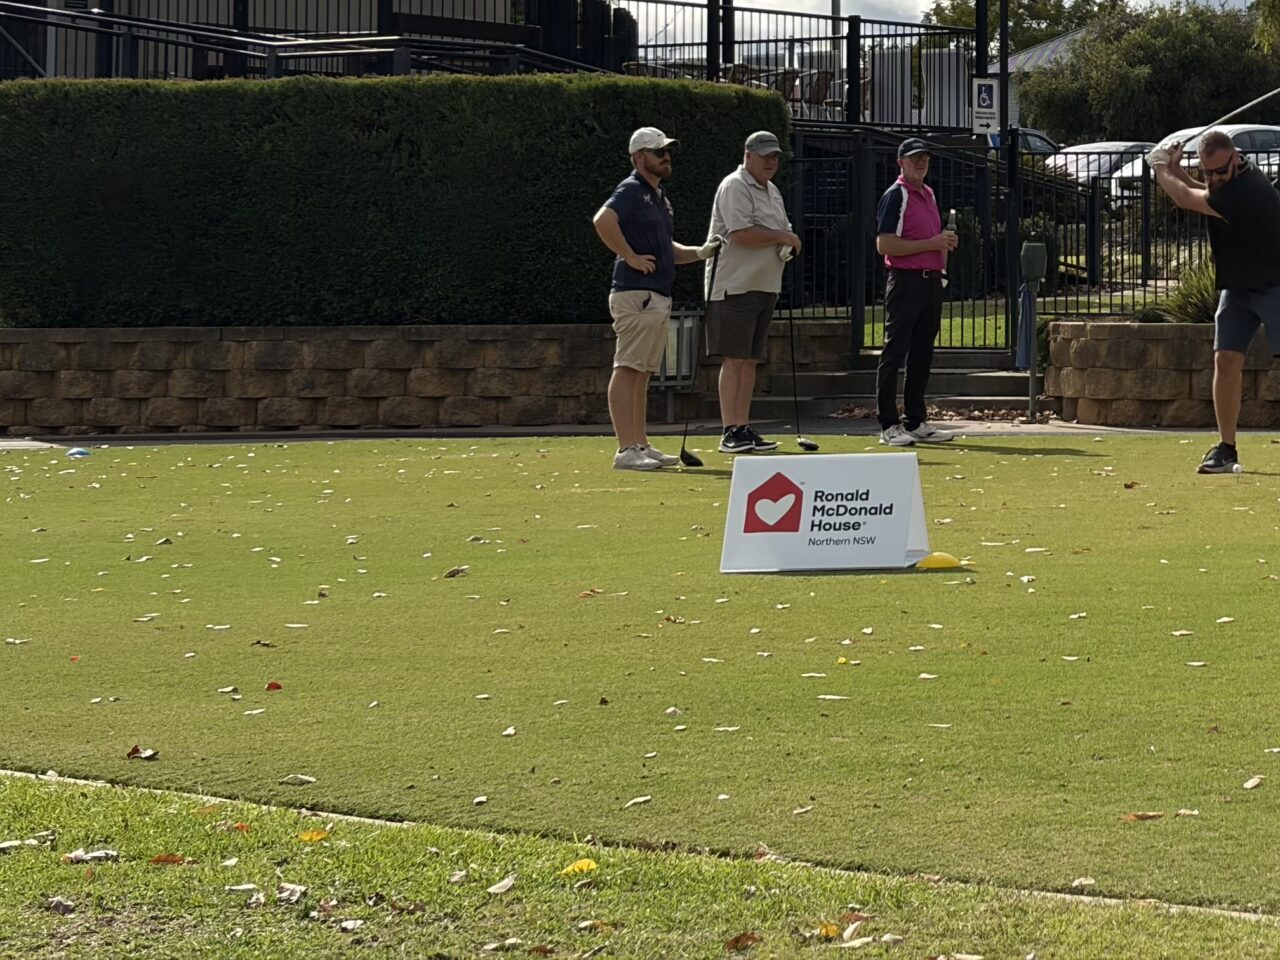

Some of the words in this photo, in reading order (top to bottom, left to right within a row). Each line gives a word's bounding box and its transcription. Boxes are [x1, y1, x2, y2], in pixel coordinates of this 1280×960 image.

[814, 489, 869, 502] Ronald
[812, 503, 893, 517] McDonald
[808, 537, 851, 546] Northern
[852, 536, 877, 545] NSW
